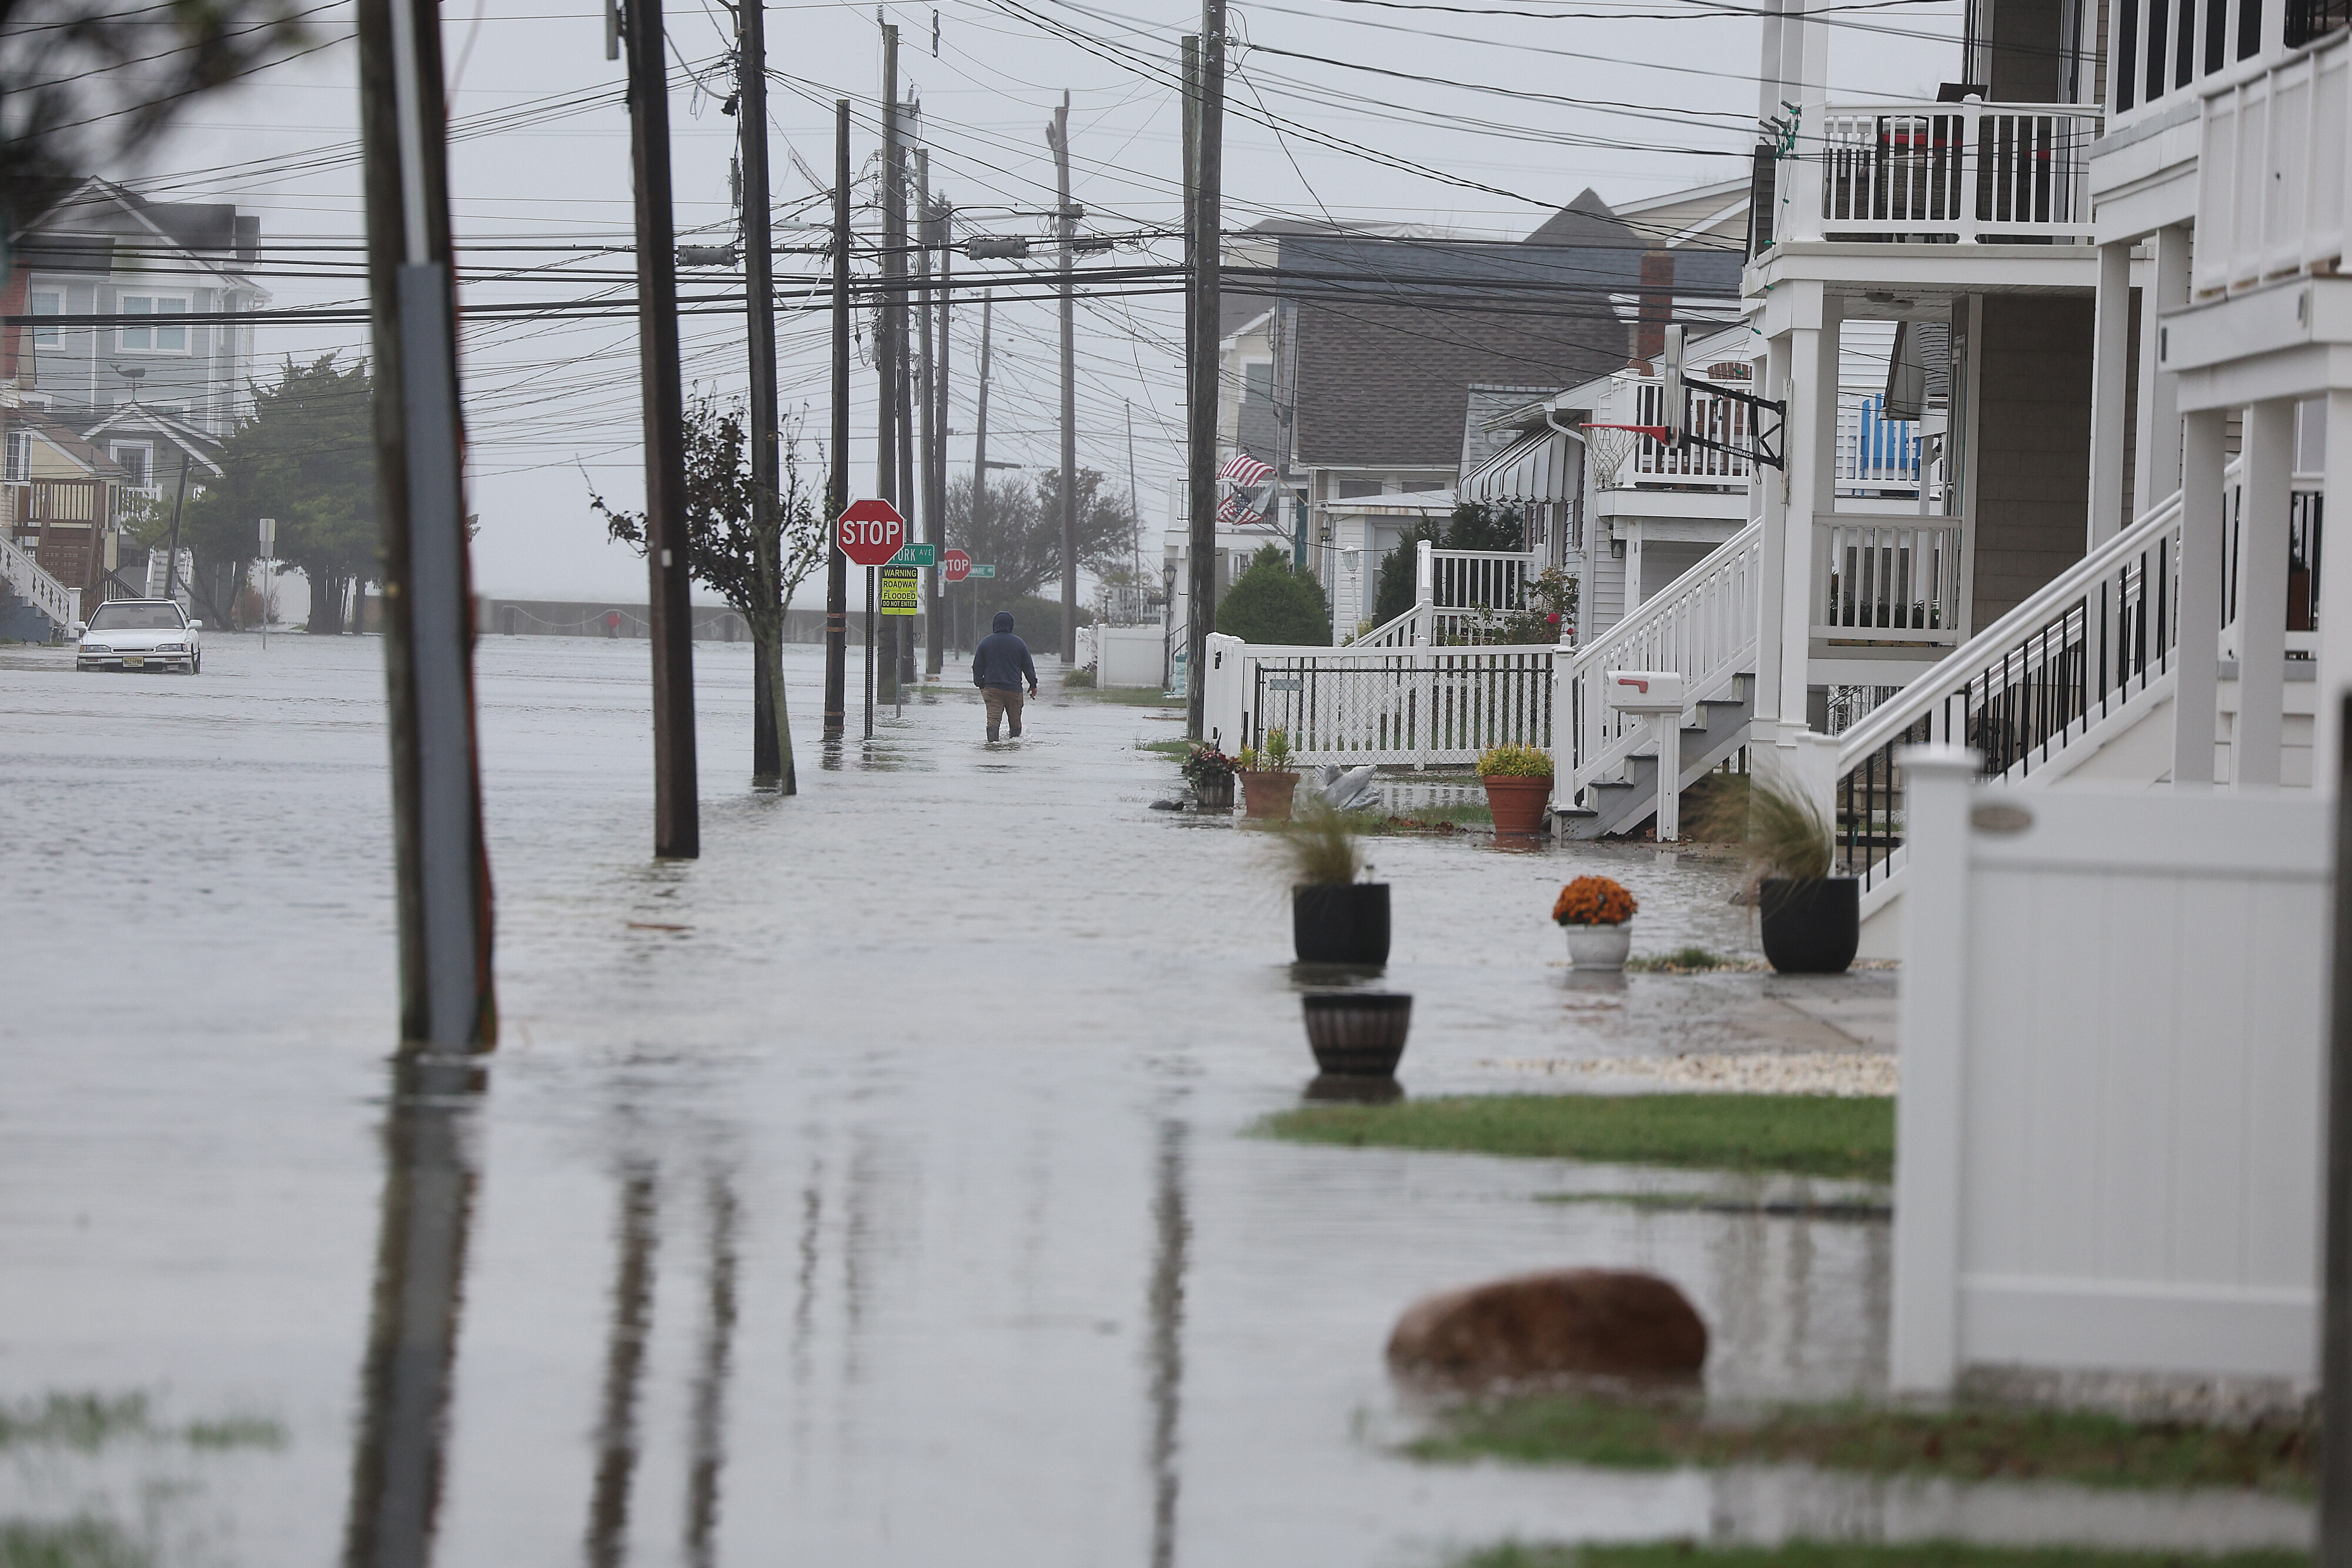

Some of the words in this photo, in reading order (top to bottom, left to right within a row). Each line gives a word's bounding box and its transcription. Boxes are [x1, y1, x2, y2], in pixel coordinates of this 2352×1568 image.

[1719, 444, 1753, 459] SILVERBACK
[842, 520, 900, 545] STOP
[884, 569, 917, 577] WARNING
